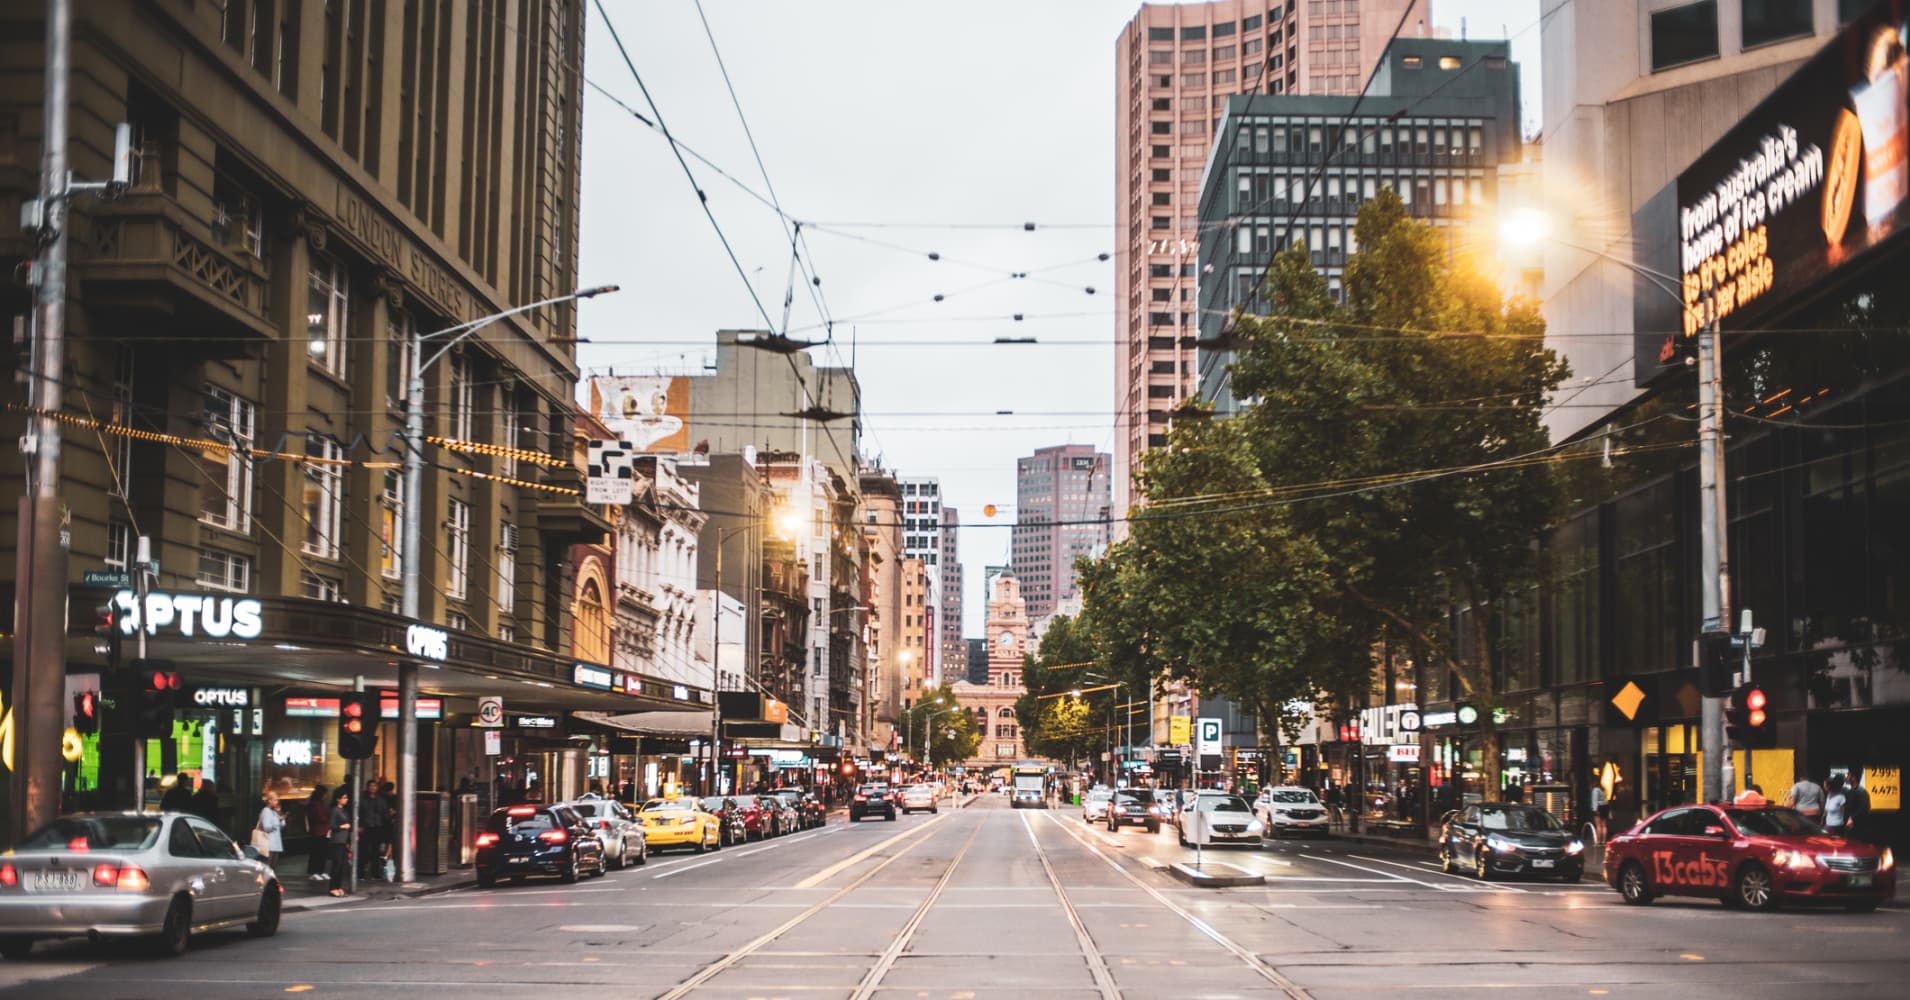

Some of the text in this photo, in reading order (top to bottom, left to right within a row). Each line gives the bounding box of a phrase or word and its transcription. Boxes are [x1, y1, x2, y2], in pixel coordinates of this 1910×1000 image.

[1681, 123, 1798, 241] from australia's
[1681, 223, 1723, 274] home
[1723, 201, 1741, 242] of
[1742, 190, 1766, 228] ice
[1767, 143, 1823, 216] cream
[336, 182, 400, 268] LONDON
[410, 252, 463, 317] STORES
[1683, 273, 1700, 304] to
[1726, 224, 1767, 277] coles
[1737, 255, 1773, 308] aisle
[91, 573, 129, 582] Bourke St
[109, 590, 262, 639] OPTUS
[406, 624, 448, 661] OPTUS
[194, 688, 248, 706] OPTUS
[482, 706, 498, 717] 40
[1205, 724, 1217, 740] P
[1653, 850, 1728, 888] 13cabs
